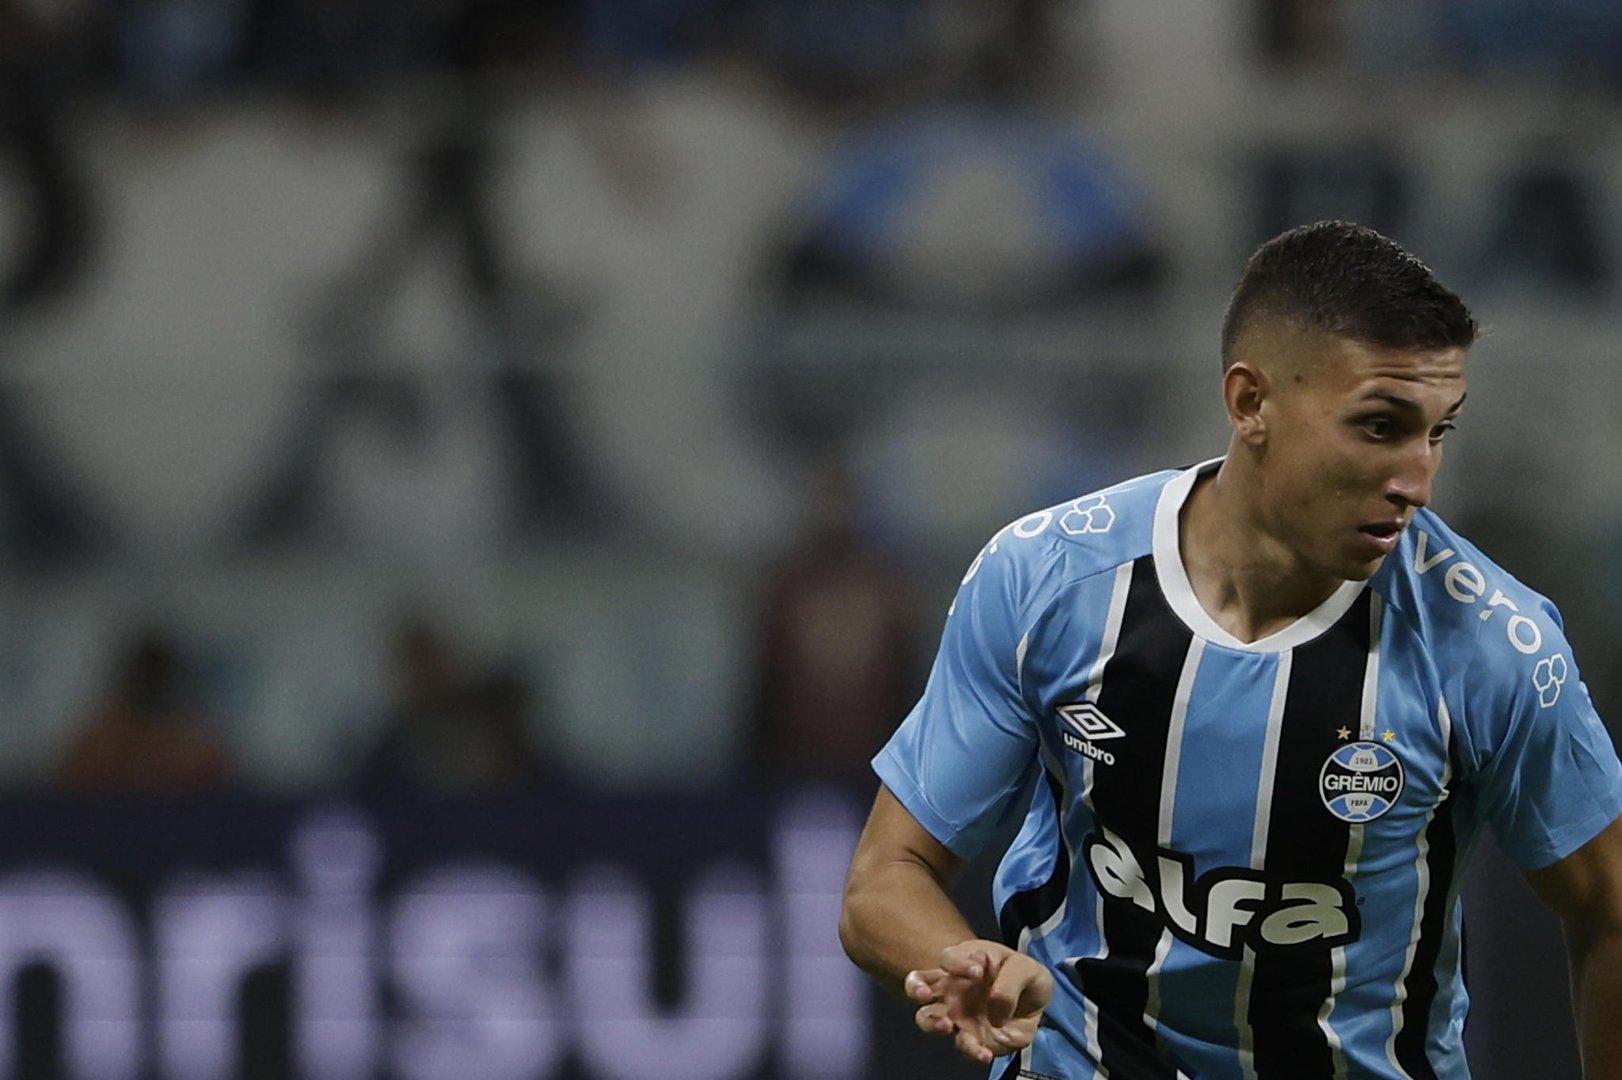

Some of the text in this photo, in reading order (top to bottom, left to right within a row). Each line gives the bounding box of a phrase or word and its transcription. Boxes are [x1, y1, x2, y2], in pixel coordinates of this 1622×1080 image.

[1414, 530, 1542, 654] vero
[1063, 732, 1116, 766] umbro
[1324, 771, 1398, 792] GRÊMIO
[1089, 825, 1349, 949] alfa
